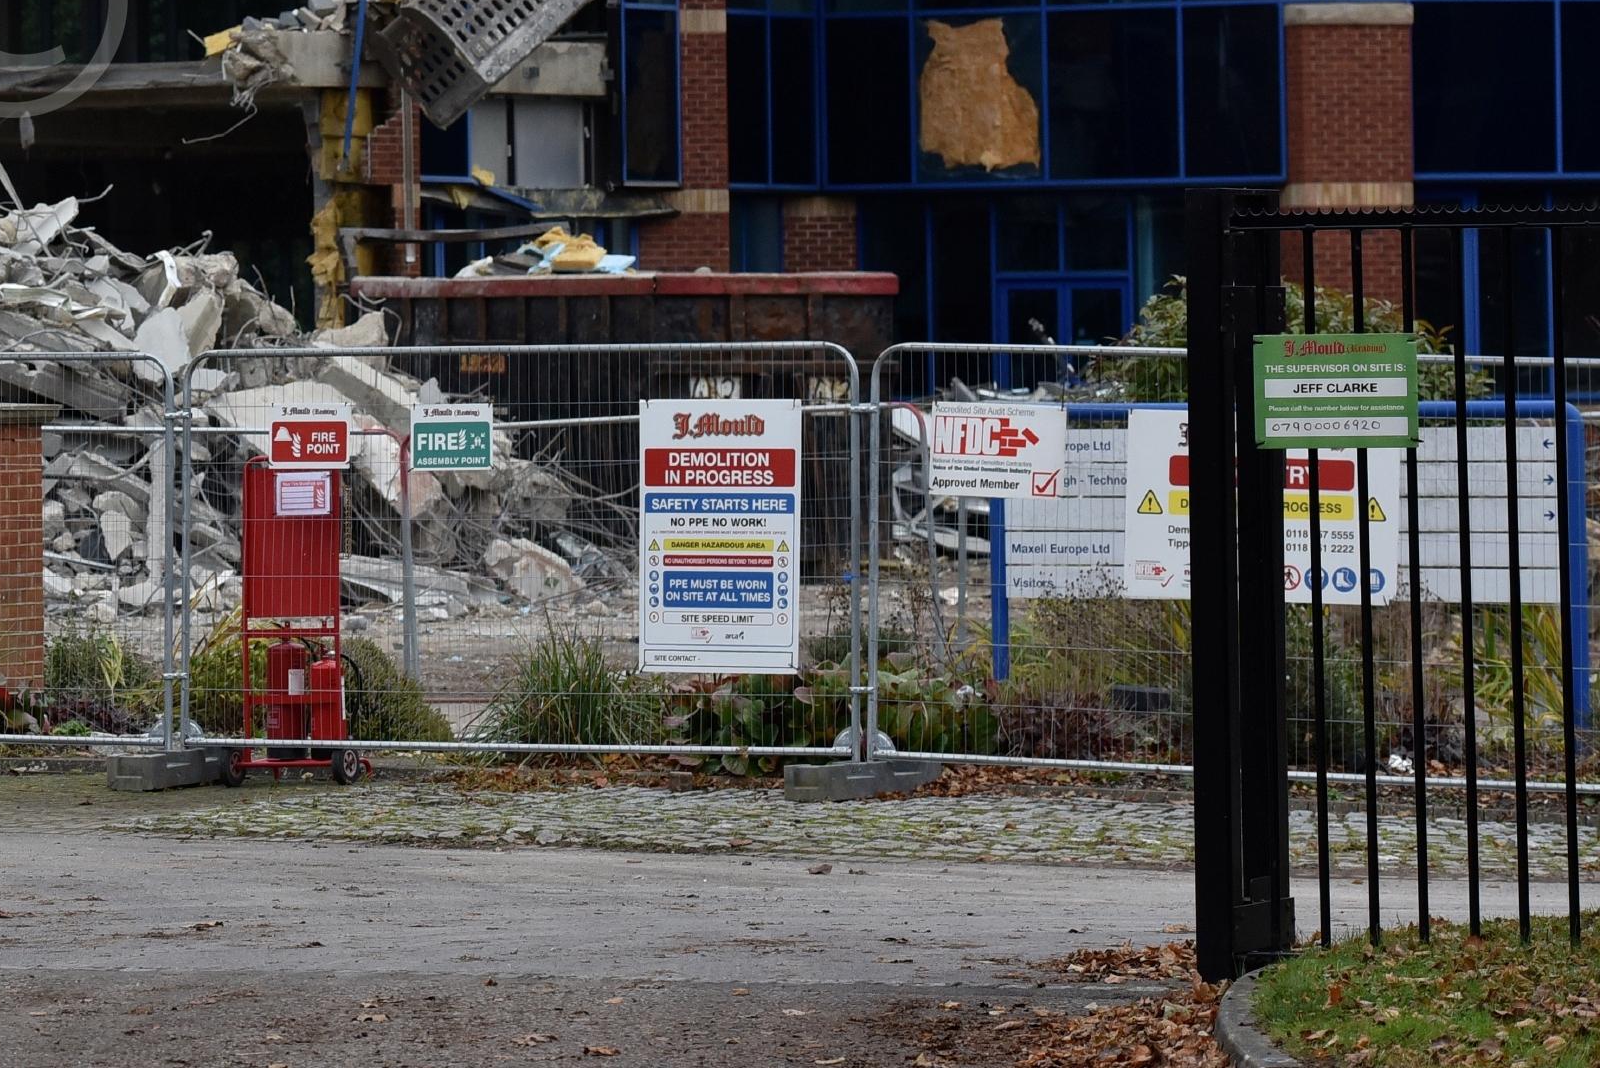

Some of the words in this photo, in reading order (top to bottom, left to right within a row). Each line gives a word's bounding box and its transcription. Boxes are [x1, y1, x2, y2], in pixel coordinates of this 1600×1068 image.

[1265, 365, 1285, 373] THE
[1286, 364, 1350, 373] SUPERVISOR
[1352, 364, 1370, 372] ON
[1372, 363, 1392, 372] SITE
[1393, 363, 1407, 372] IS:
[1293, 383, 1323, 394] JEFF
[1326, 382, 1378, 394] CLARKE
[1007, 407, 1035, 416] Scheme
[1272, 420, 1381, 432] 07900006920
[311, 431, 337, 443] FIRE
[417, 432, 459, 451] FIRE
[935, 416, 1002, 455] NFDC
[306, 443, 341, 455] POINT
[1064, 442, 1090, 453] rope
[1092, 441, 1111, 451] Ltd
[417, 457, 460, 465] ASSEMBLY
[461, 456, 487, 465] POINT
[668, 452, 770, 467] DEMOLITION
[664, 469, 681, 484] IN
[685, 469, 775, 485] PROGRESS
[932, 476, 977, 489] Approved
[980, 479, 1020, 490] Member
[1087, 475, 1128, 486] Techno
[651, 498, 698, 510] SAFETY
[701, 498, 749, 511] STARTS
[752, 499, 788, 511] HERE
[670, 517, 686, 527] NO
[688, 518, 709, 527] PPE
[712, 518, 728, 527] NO
[731, 518, 767, 528] WORK!
[1286, 529, 1309, 538] 0118
[1331, 531, 1354, 540] 5555
[671, 541, 699, 549] DANGER
[701, 541, 745, 549] HAZARDOUS
[1011, 543, 1047, 554] Maxell
[1050, 543, 1089, 556] Europe
[1092, 543, 1110, 554] Ltd
[1286, 543, 1308, 552] 0118
[1331, 544, 1354, 553] 2222
[669, 579, 688, 589] PPE
[690, 579, 719, 589] MUST
[720, 579, 733, 589] BE
[735, 580, 767, 590] WORN
[1013, 577, 1054, 588] Visitors
[665, 591, 681, 601] ON
[682, 592, 704, 602] SITE
[705, 592, 717, 602] AT
[719, 592, 738, 602] ALL
[739, 592, 771, 603] TIMES
[681, 615, 699, 623] SITE
[701, 615, 730, 623] SPEED
[731, 615, 754, 624] LIMIT
